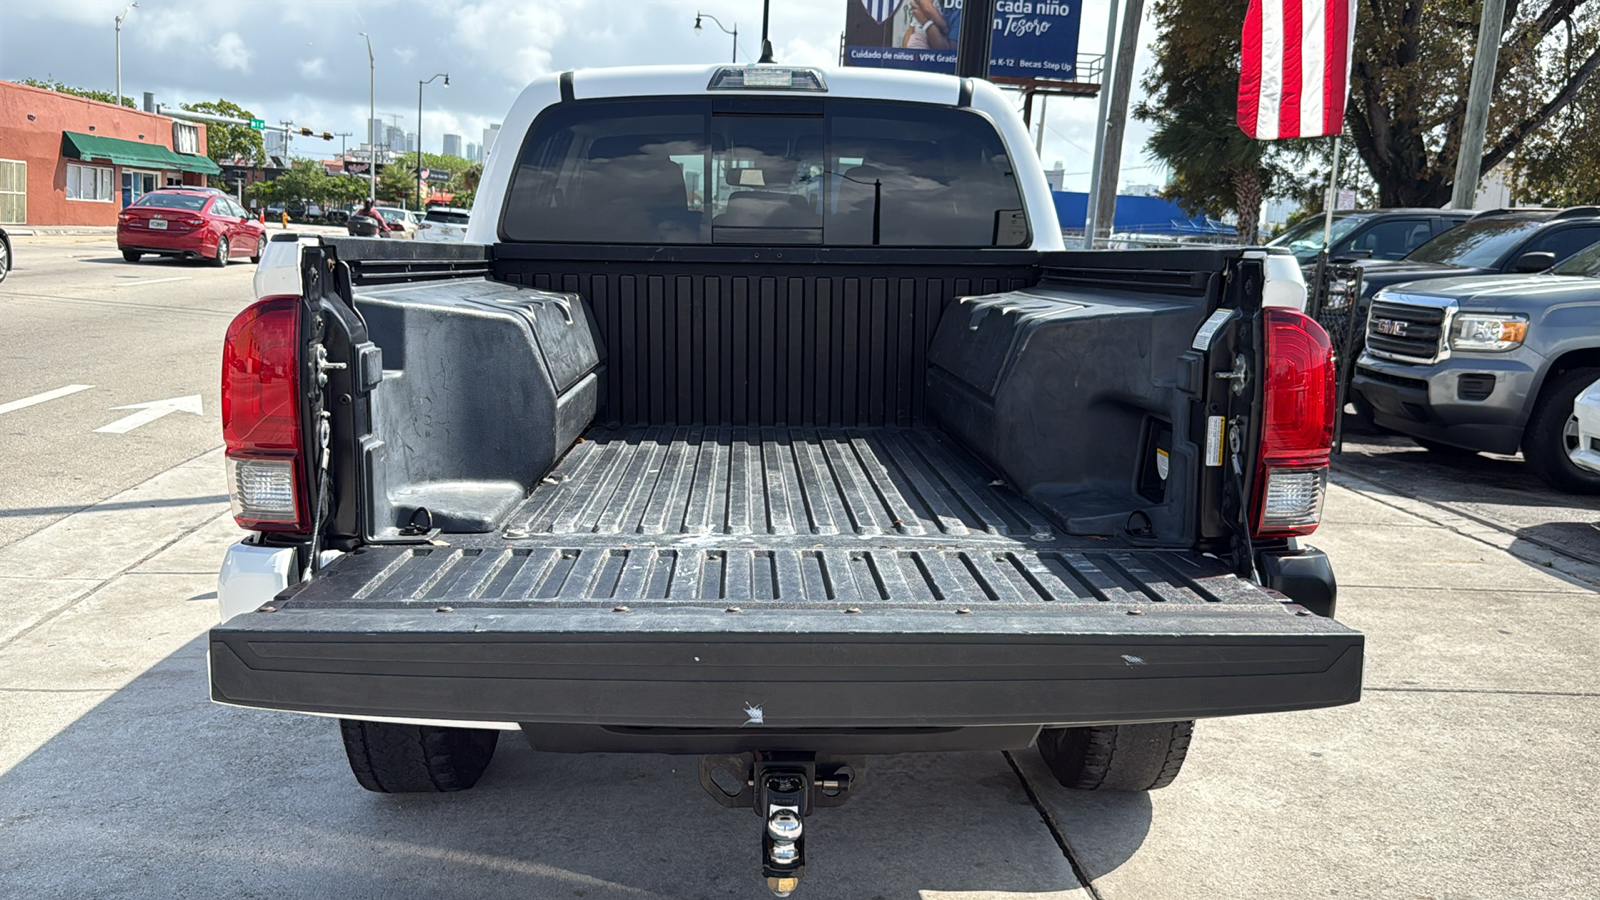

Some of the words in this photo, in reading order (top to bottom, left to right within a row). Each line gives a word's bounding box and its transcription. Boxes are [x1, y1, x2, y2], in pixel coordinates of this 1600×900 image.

[996, 0, 1032, 14] cada
[1036, 0, 1070, 16] niño
[1003, 14, 1052, 36] Tesoro
[851, 50, 881, 59] Cuidado
[882, 51, 892, 59] de
[893, 52, 914, 61] niños
[919, 53, 935, 62] VPK
[997, 58, 1014, 67] K-12
[1019, 60, 1042, 69] Becas
[1043, 61, 1060, 72] Step
[1061, 63, 1072, 73] Up
[1377, 319, 1408, 336] GMC
